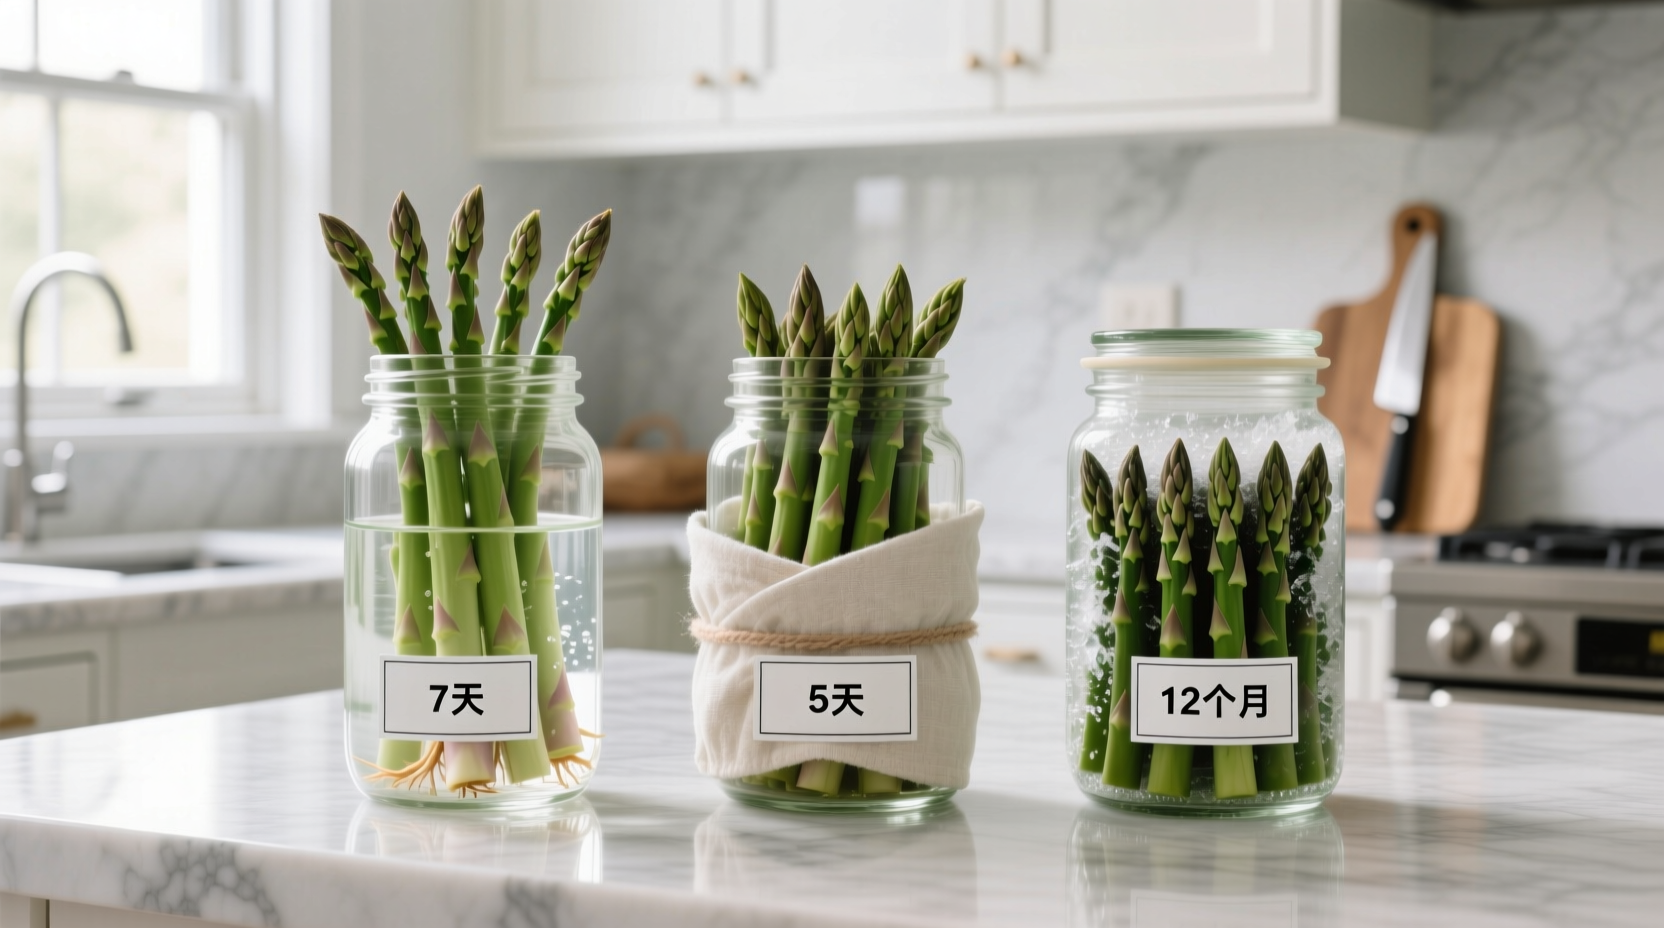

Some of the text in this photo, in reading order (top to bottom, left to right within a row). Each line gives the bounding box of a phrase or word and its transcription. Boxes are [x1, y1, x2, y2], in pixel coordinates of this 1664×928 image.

[430, 684, 484, 716] 7天
[809, 684, 864, 716] 5天
[1162, 684, 1267, 718] 12个月
